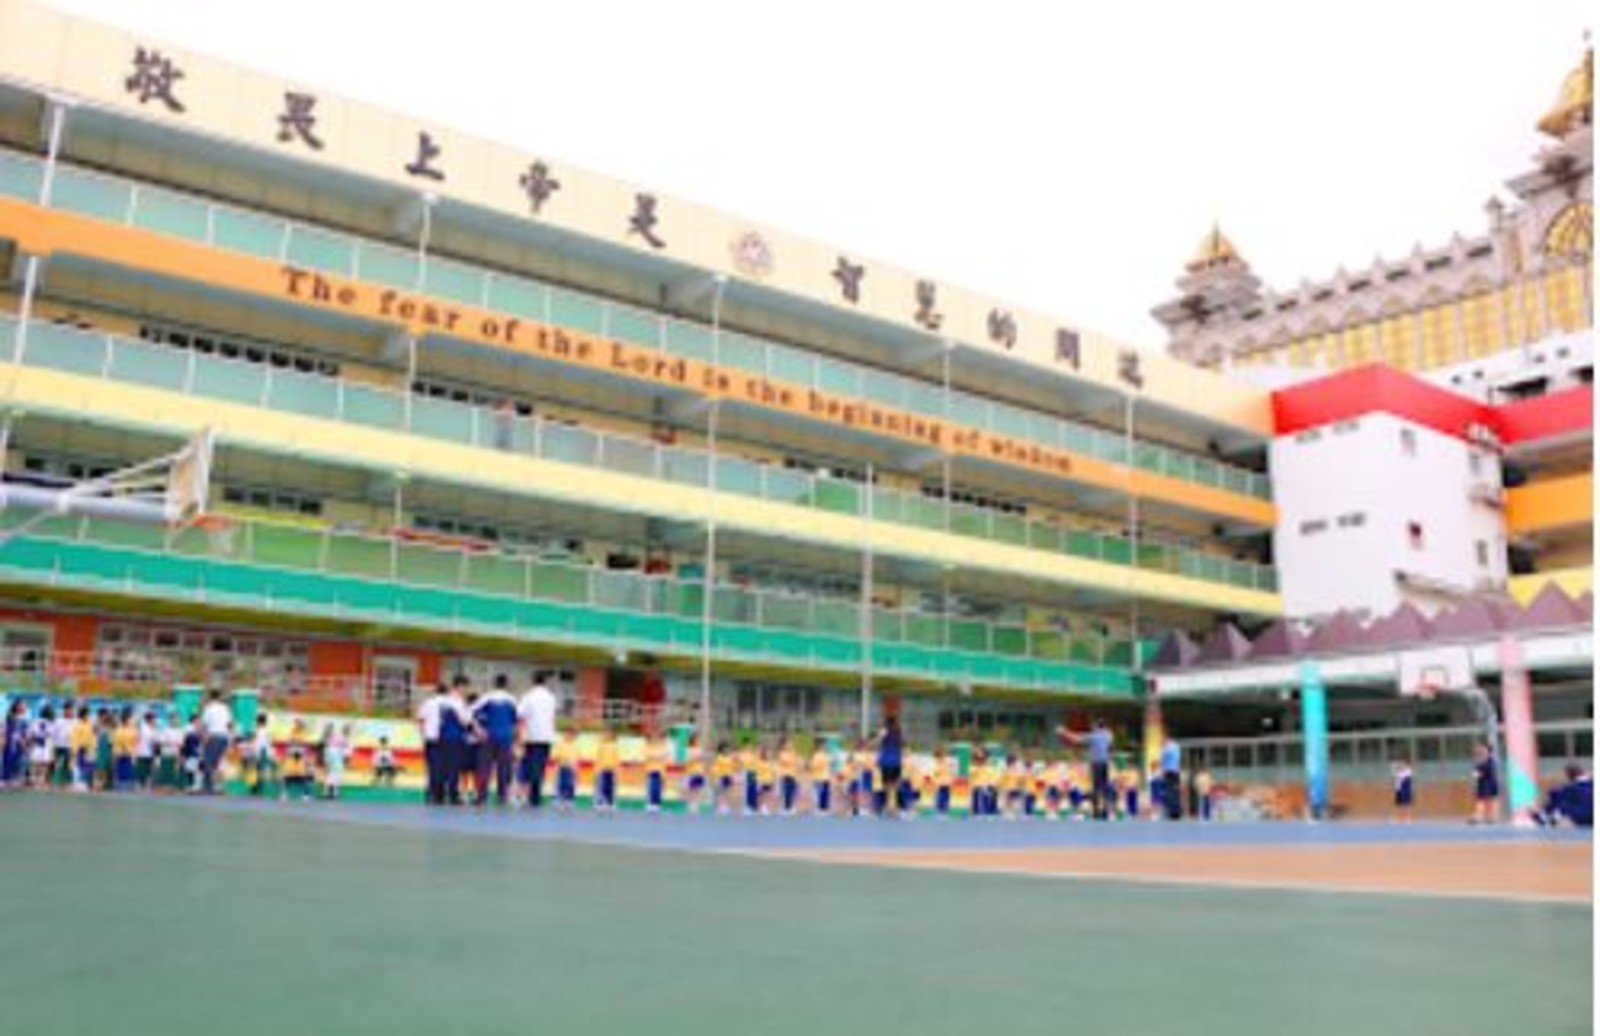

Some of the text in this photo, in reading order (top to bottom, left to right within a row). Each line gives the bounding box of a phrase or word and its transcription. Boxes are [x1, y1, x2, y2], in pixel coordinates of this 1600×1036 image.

[125, 46, 668, 249] 敬畏上帝是
[282, 265, 1072, 473] The fear of the Lord is the beginning of wisdom
